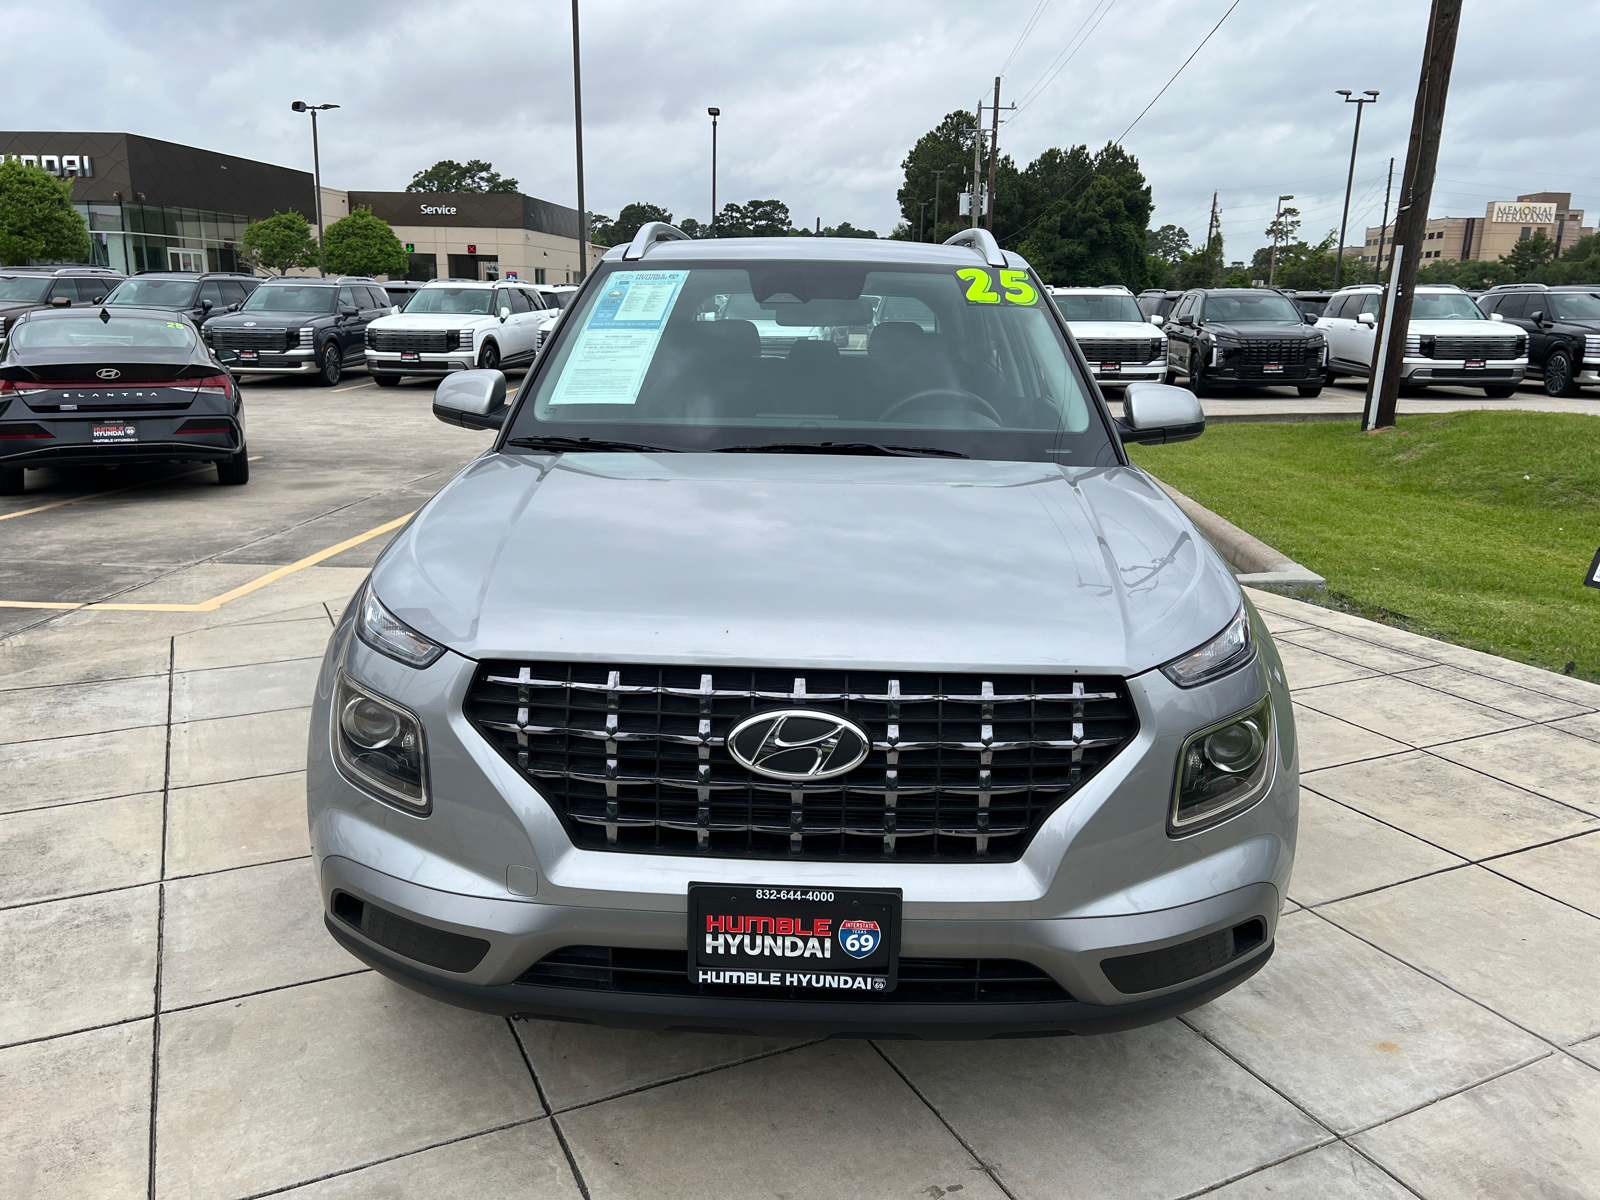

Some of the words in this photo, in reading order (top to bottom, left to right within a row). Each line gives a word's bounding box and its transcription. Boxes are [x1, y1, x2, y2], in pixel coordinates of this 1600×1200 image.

[420, 204, 457, 215] Service
[1495, 213, 1553, 222] HERMANN
[1497, 205, 1553, 216] MEMORIAL
[956, 268, 1039, 306] 25
[755, 889, 835, 902] 832-644-4000
[706, 915, 832, 936] HUMBLE
[705, 933, 832, 958] HYUNDAI
[845, 934, 874, 952] 69
[698, 970, 782, 985] HUMBLE
[785, 973, 872, 990] HYUNDAI
